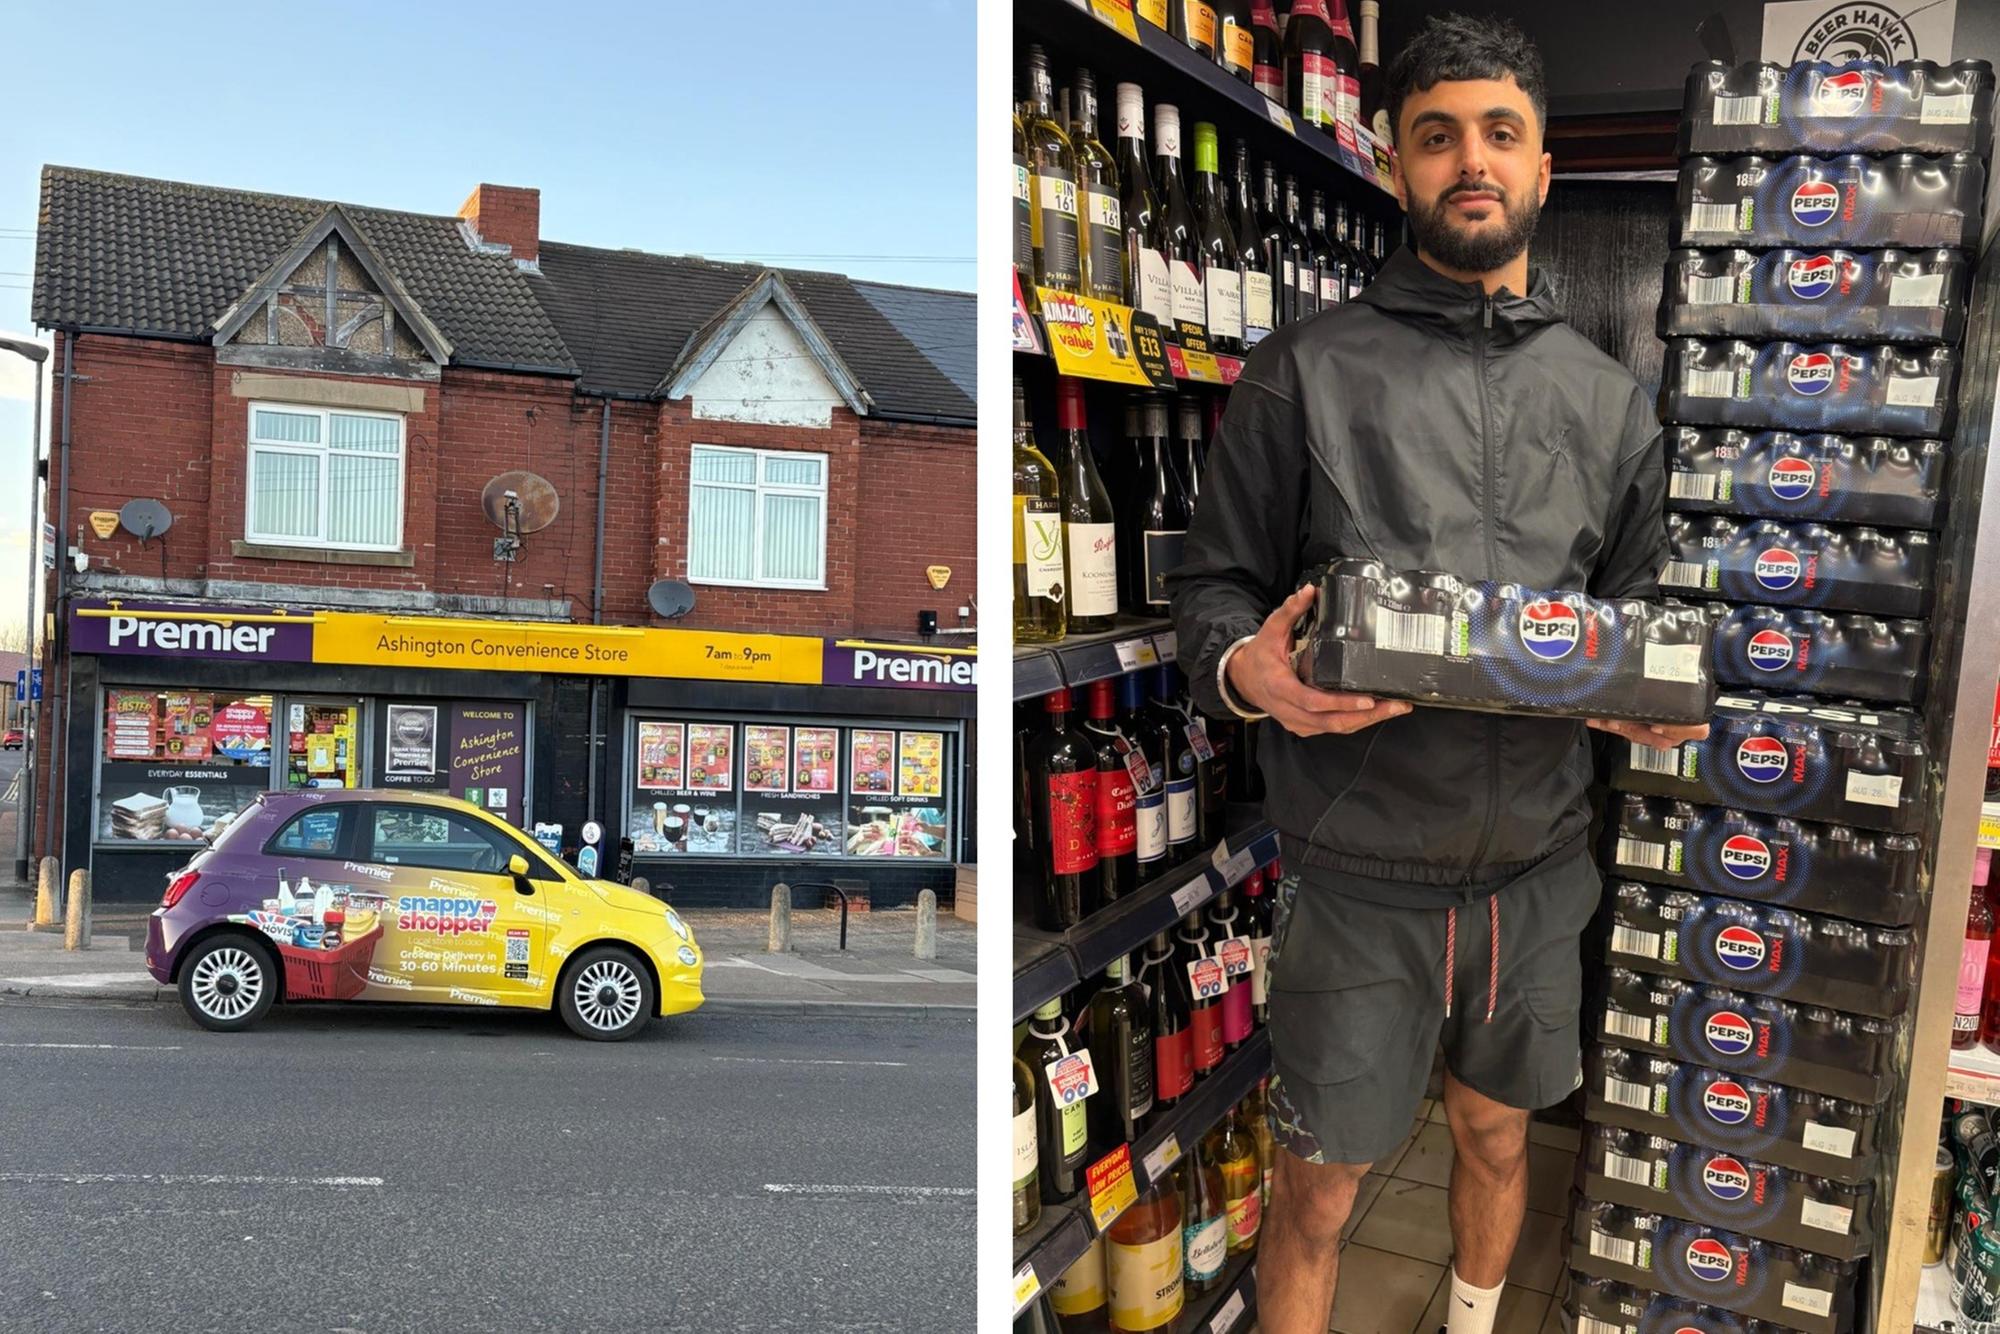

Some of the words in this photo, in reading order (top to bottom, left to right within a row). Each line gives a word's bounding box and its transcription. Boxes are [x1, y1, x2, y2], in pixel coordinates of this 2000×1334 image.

[1805, 14, 1848, 55] BEER
[1853, 10, 1906, 50] HAWK
[1821, 88, 1863, 99] PPSI
[1055, 180, 1074, 196] BIN
[1736, 174, 1748, 186] 18
[1055, 196, 1075, 212] 161
[1102, 196, 1118, 213] BIN
[1794, 197, 1837, 209] PEPSI
[1844, 184, 1857, 221] MAX
[1102, 211, 1119, 226] 161
[1791, 269, 1834, 282] PEPSI
[1840, 258, 1853, 295] MAX
[1044, 301, 1094, 327] AMAZING
[1181, 323, 1204, 337] SPECIAL
[1059, 331, 1094, 351] value
[1140, 336, 1160, 358] £13
[1186, 338, 1207, 351] OFFERS
[1790, 368, 1832, 379] PEPSI
[1840, 358, 1851, 393] MAX
[1715, 446, 1727, 458] 18
[1771, 472, 1813, 484] PEPSI
[1819, 463, 1833, 497] MAX
[1702, 536, 1714, 548] 18
[1757, 564, 1798, 574] PEPSI
[1804, 556, 1819, 589] MAX
[108, 616, 275, 653] Premier
[1523, 620, 1576, 637] PEPSI
[1585, 612, 1598, 658] MAX
[377, 635, 464, 657] Ashington
[470, 638, 579, 660] Convenience
[584, 644, 629, 661] Store
[705, 645, 732, 659] 7am
[743, 647, 771, 663] 9pm
[1751, 645, 1790, 657] PEPSI
[1797, 639, 1810, 671] MAX
[117, 702, 151, 714] EASTER
[462, 711, 501, 719] WELCOME
[460, 729, 514, 749] Ashington
[393, 758, 429, 766] Premier
[454, 745, 520, 768] Convenience
[1740, 752, 1785, 766] PEPSI
[1792, 746, 1806, 783] MAX
[148, 770, 184, 778] EVERYDAY
[185, 771, 228, 779] ESSENTIALS
[471, 764, 502, 780] Store
[1664, 816, 1678, 829] 18
[1723, 850, 1767, 867] PEPSI
[1776, 845, 1789, 881] MAX
[344, 862, 394, 879] Premier
[429, 880, 479, 898] Premier
[400, 896, 482, 918] snappy
[514, 901, 562, 921] Premier
[1659, 905, 1671, 918] 18
[262, 924, 293, 937] HOVIS
[399, 912, 493, 936] shopper
[442, 951, 486, 963] Delivery
[487, 951, 497, 960] in
[1719, 940, 1762, 957] PEPSI
[1769, 938, 1783, 972] MAX
[400, 961, 438, 972] 30-60
[442, 963, 497, 973] Minutes
[450, 988, 499, 1005] Premier
[1650, 992, 1662, 1005] 18
[1708, 1026, 1750, 1041] PEPSI
[1757, 1025, 1771, 1058] MAX
[1650, 1060, 1662, 1073] 18
[1707, 1094, 1747, 1111] PEPSI
[1755, 1094, 1768, 1127] MAX
[1650, 1136, 1662, 1149] 18
[1092, 1147, 1126, 1178] EVERYDAY
[1092, 1177, 1106, 1194] LOW
[1107, 1160, 1130, 1184] PRICES
[1706, 1170, 1747, 1187] PEPSI
[1754, 1171, 1767, 1204] MAX
[1634, 1217, 1646, 1229] 18
[1689, 1252, 1730, 1268] PEPSI
[1736, 1252, 1748, 1286] MAX
[1620, 1303, 1632, 1315] 18
